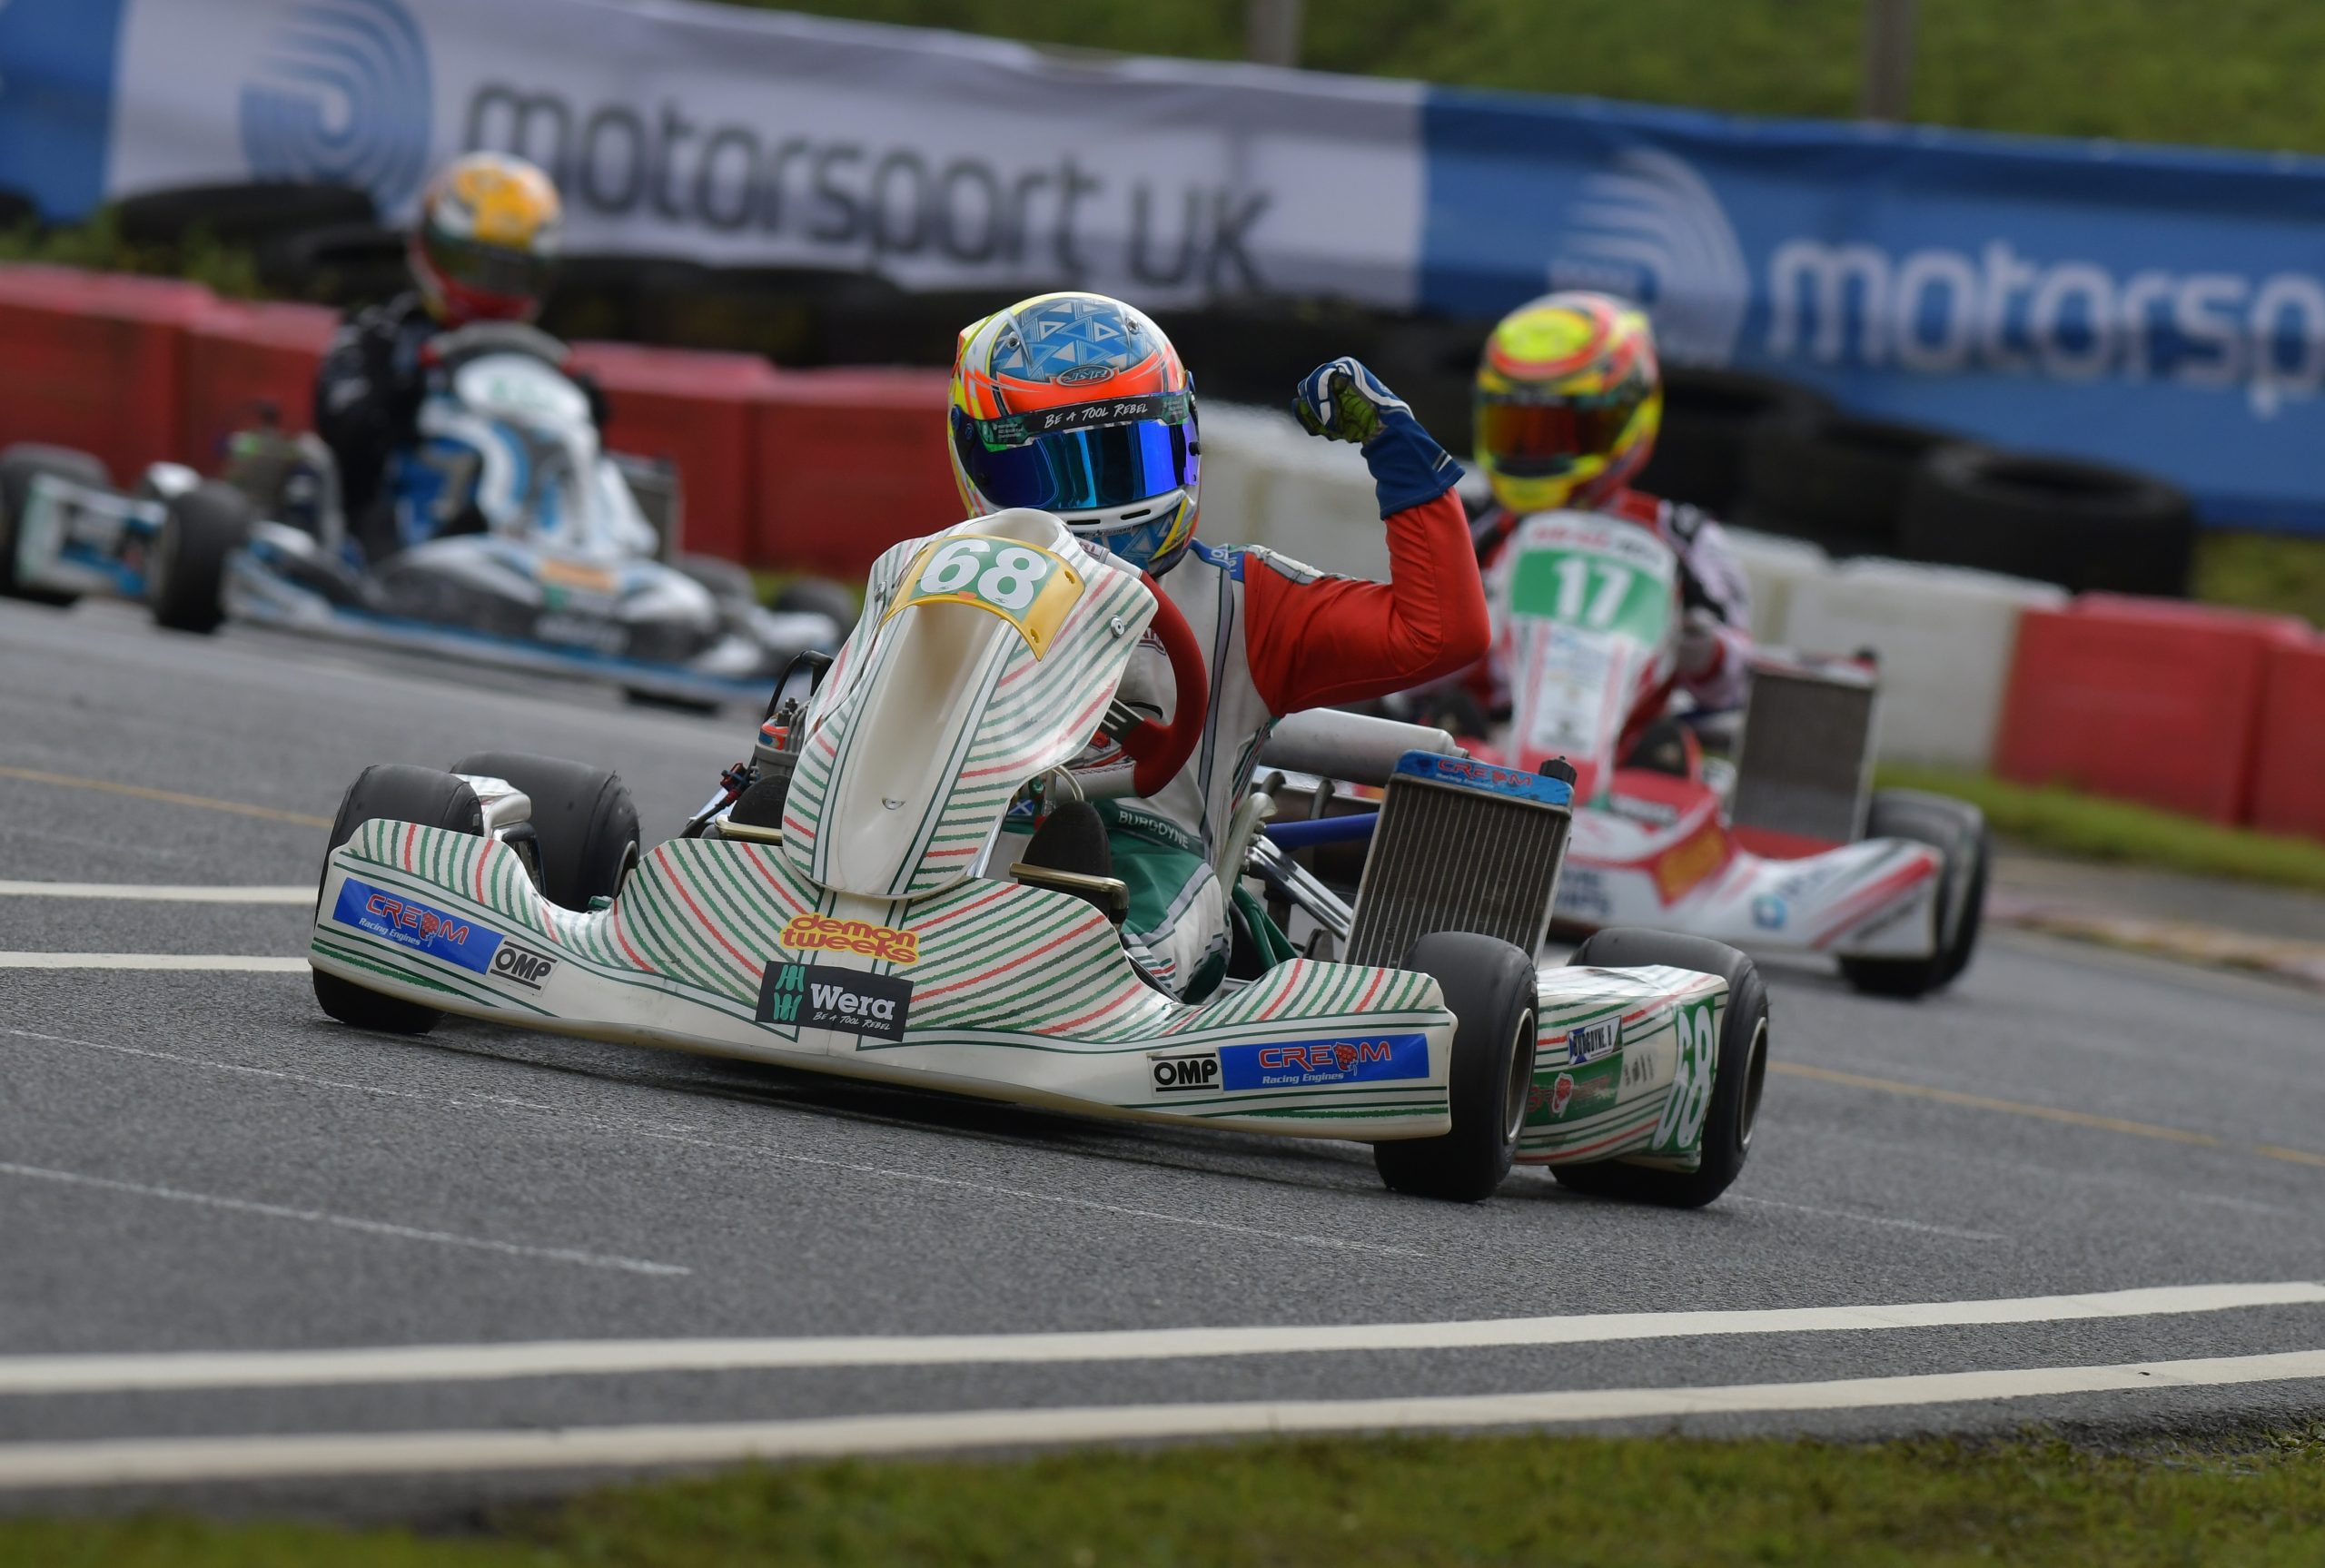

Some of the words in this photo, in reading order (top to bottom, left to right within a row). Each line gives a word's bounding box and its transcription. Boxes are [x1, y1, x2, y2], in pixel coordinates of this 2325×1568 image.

[465, 80, 1109, 278] motorsport
[1126, 173, 1274, 294] UK
[1044, 413, 1064, 429] BE
[1066, 411, 1076, 421] A
[1082, 407, 1109, 421] TOOL
[1113, 403, 1148, 418] REBEL
[920, 539, 1047, 610] 68
[1554, 557, 1633, 626] 17
[358, 917, 389, 935] Racing
[390, 928, 420, 946] Engines
[783, 928, 916, 963] tweeks
[791, 914, 915, 948] demon
[495, 948, 551, 981] OMP
[810, 982, 895, 1021] Wera
[840, 1015, 859, 1025] TOOL
[862, 1019, 891, 1030] REBEL
[1153, 1059, 1218, 1085] OMP
[1261, 1073, 1299, 1085] Racing
[1302, 1071, 1344, 1083] Engines
[1652, 1005, 1713, 1150] 68
